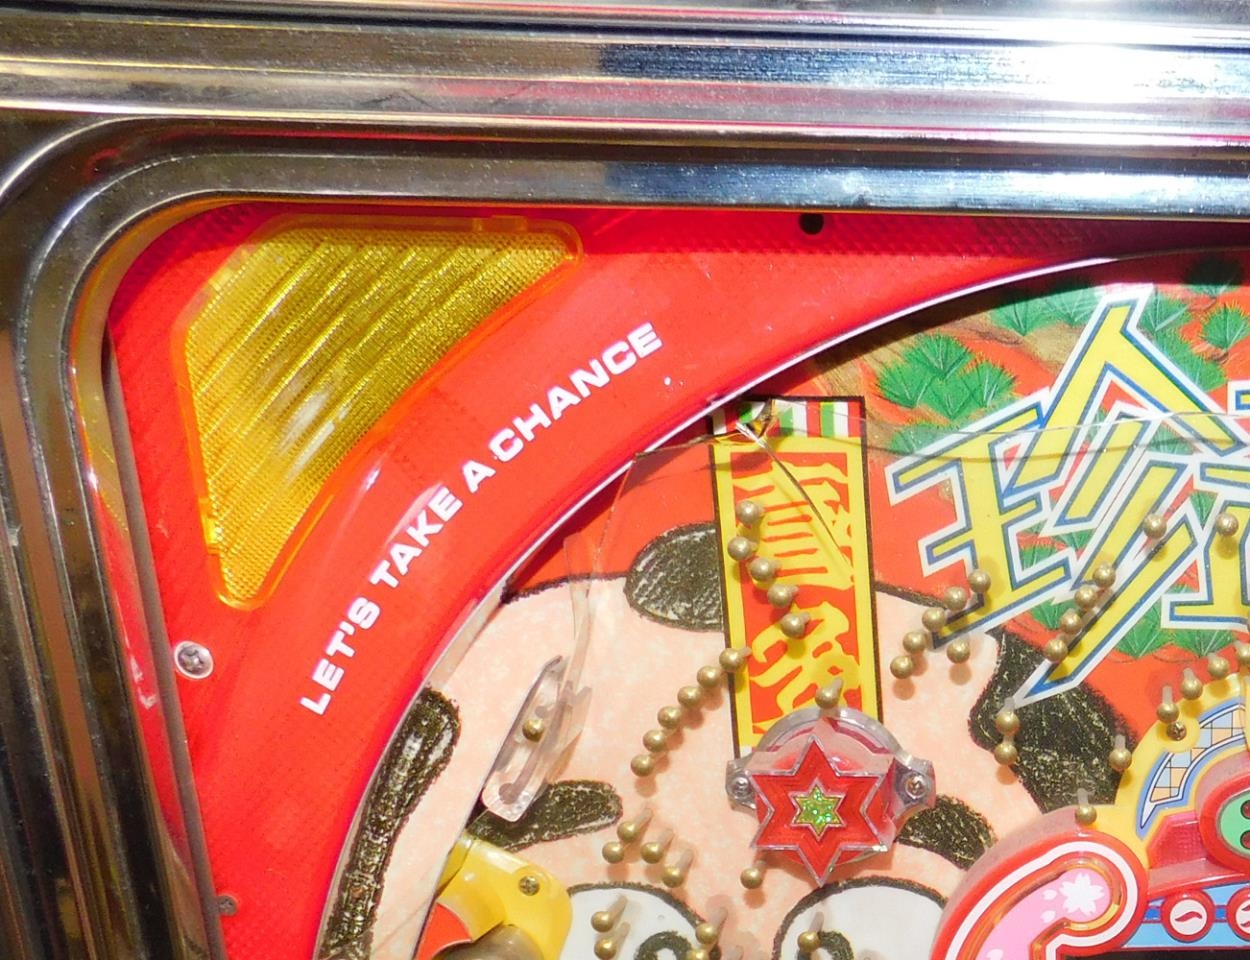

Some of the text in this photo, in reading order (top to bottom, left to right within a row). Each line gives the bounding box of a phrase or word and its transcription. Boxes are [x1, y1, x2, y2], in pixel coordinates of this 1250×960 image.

[299, 321, 665, 716] LET'S TAKE A CHANCE
